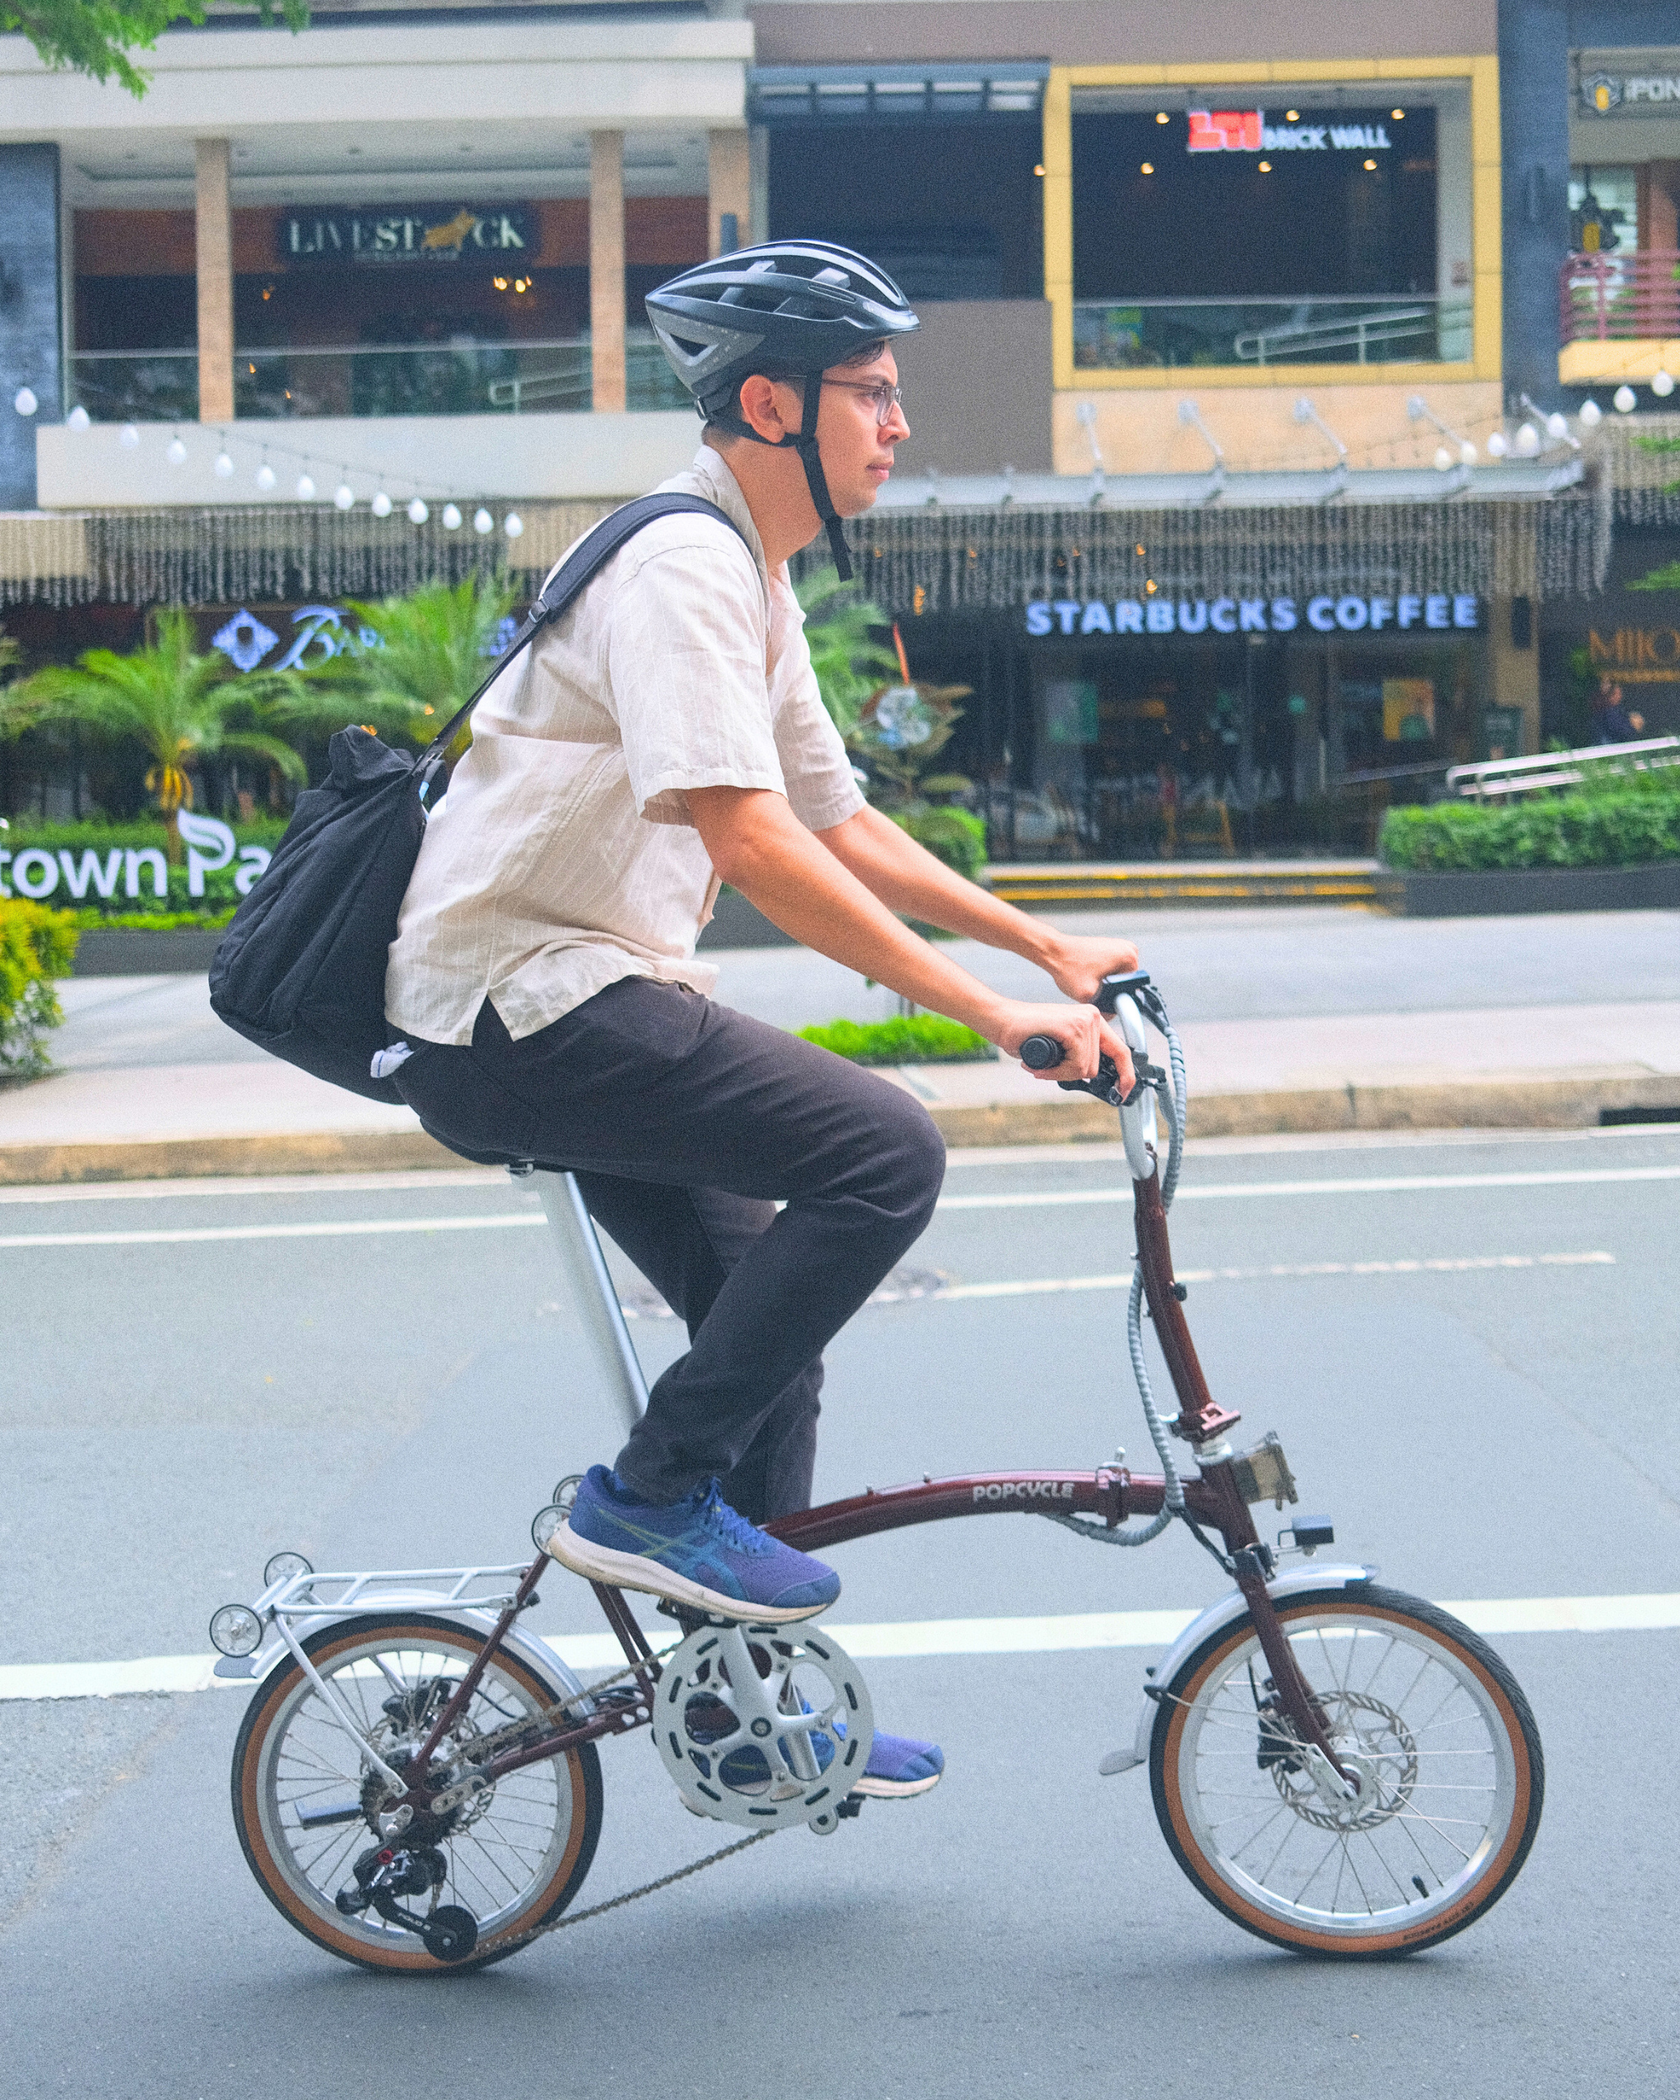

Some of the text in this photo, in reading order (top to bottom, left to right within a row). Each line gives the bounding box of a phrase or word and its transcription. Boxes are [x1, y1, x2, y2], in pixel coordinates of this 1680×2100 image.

[1263, 125, 1391, 150] BRICK WALL
[1026, 594, 1478, 636] STARBUCKS COFFEE
[177, 808, 273, 898] Pa
[973, 1482, 1075, 1502] POPCYCLE
